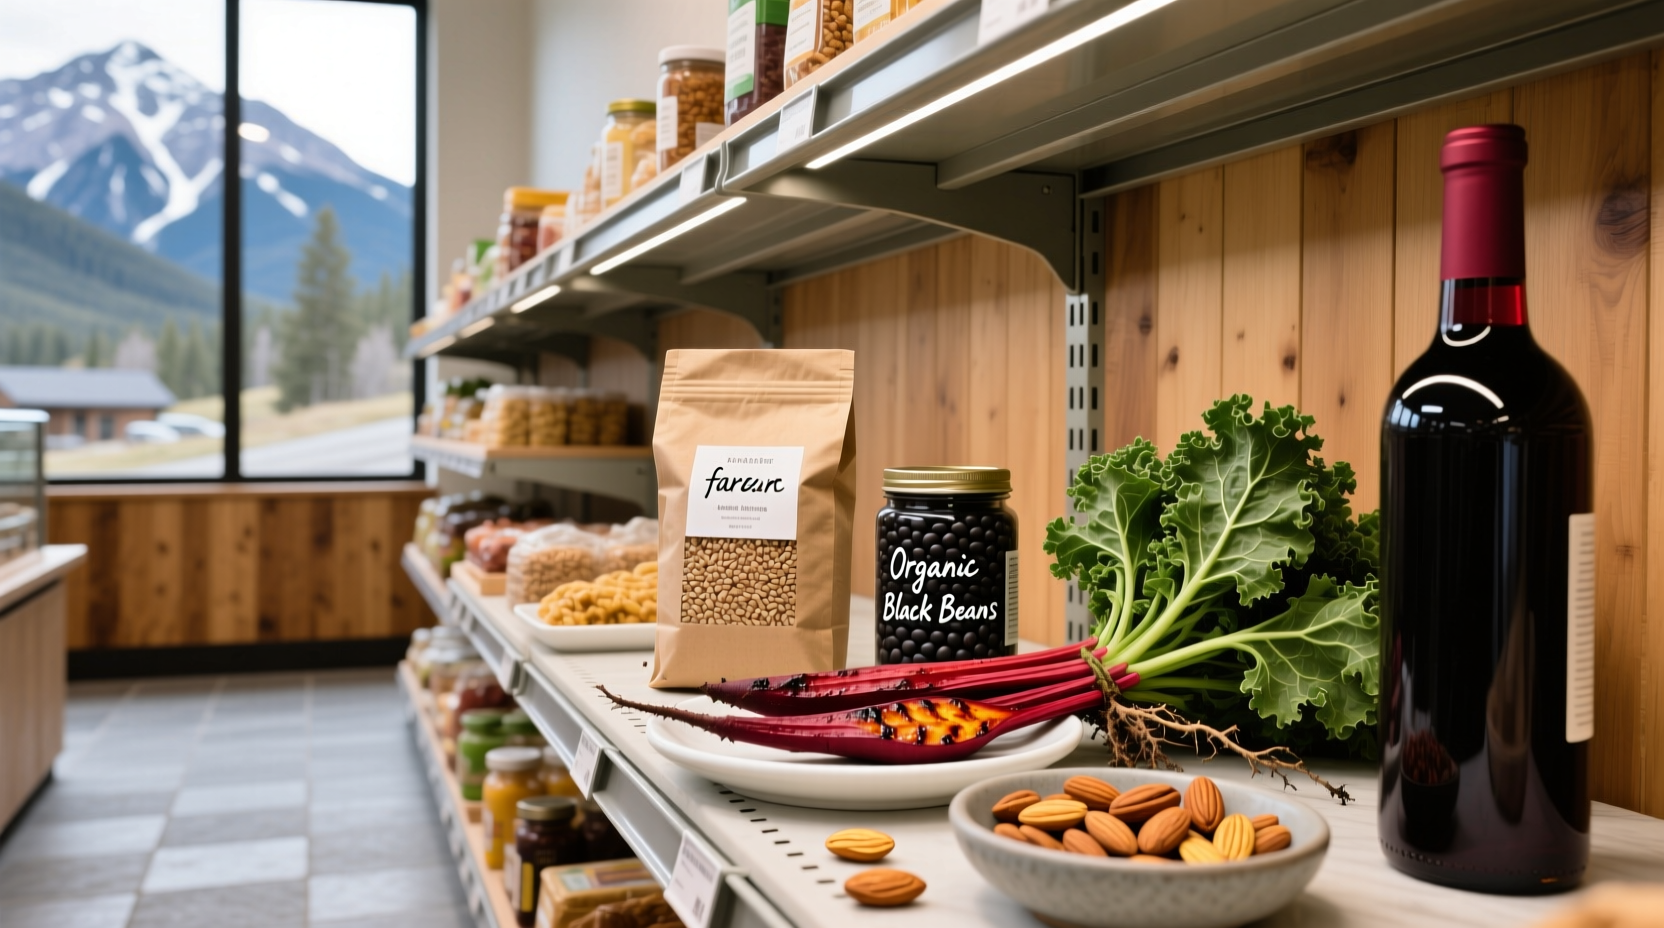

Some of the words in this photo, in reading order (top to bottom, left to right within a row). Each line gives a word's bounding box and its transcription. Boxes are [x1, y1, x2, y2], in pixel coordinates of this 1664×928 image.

[890, 546, 980, 595] Organic
[882, 591, 933, 622] Black
[938, 593, 998, 624] Beans
